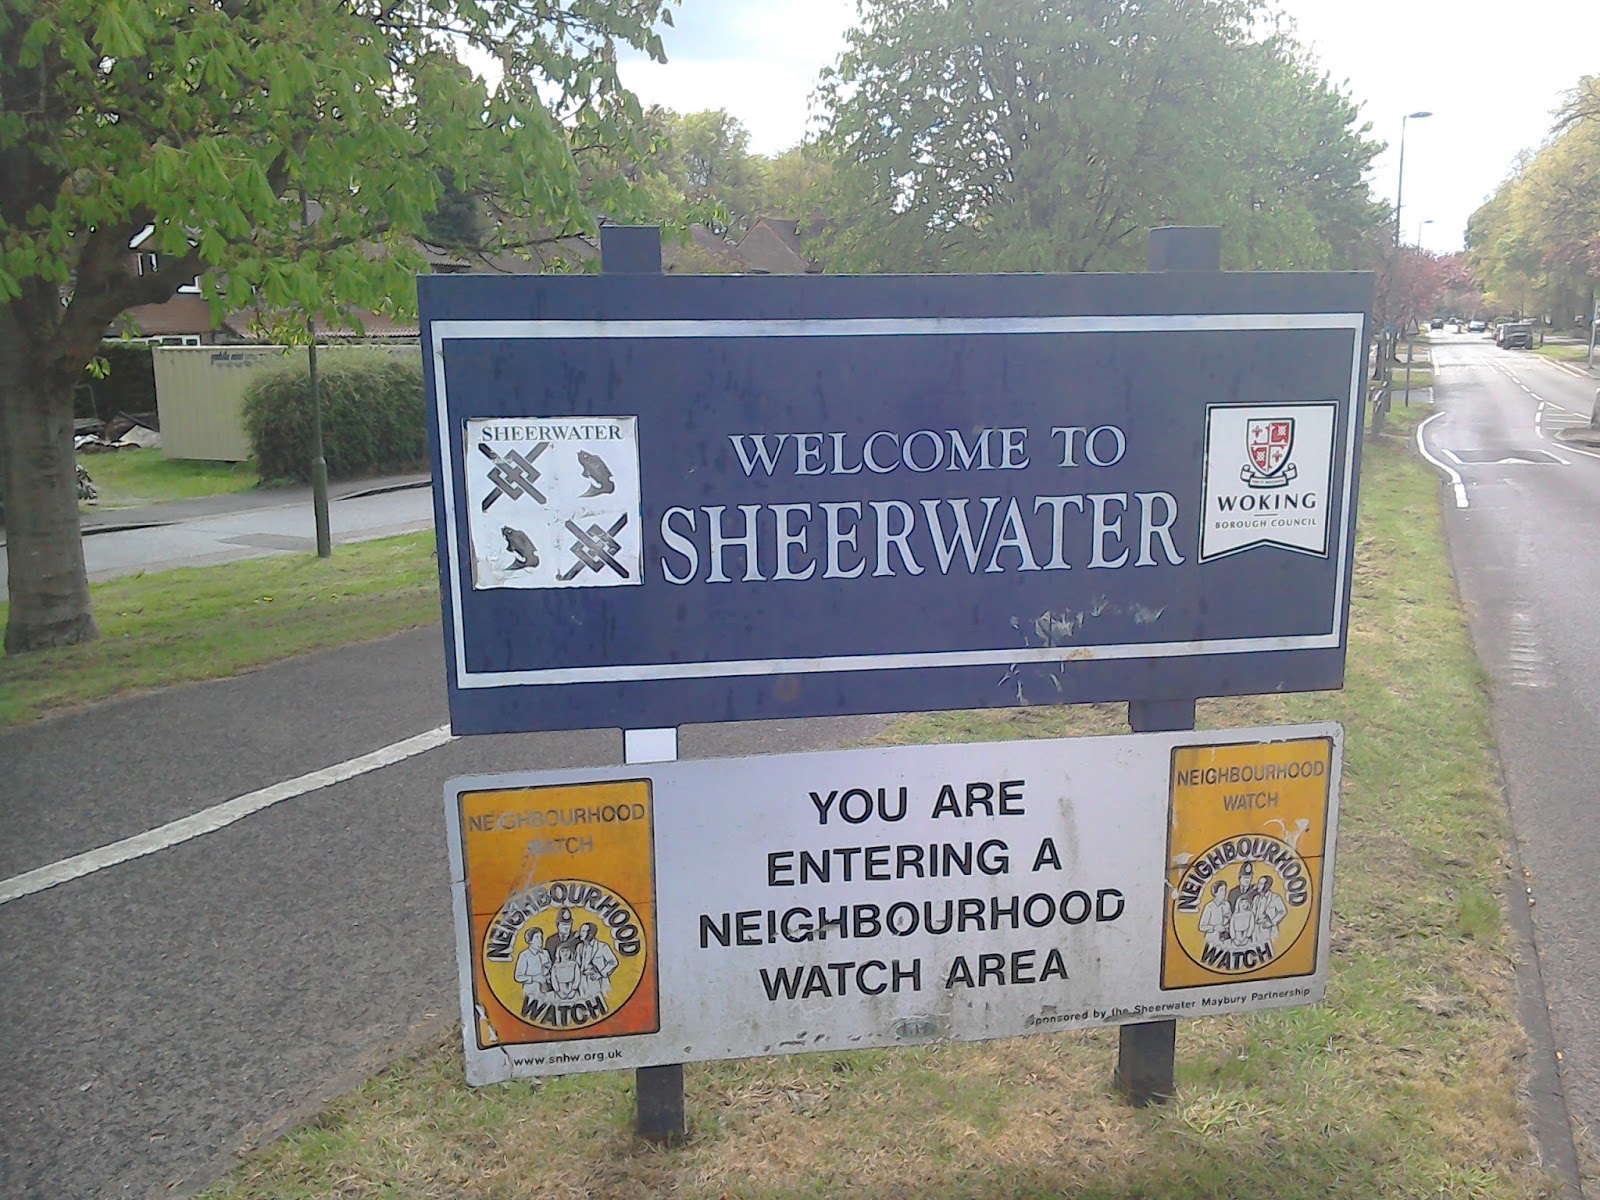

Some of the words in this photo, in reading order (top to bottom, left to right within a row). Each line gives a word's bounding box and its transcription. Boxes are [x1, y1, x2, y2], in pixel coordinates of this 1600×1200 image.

[482, 425, 623, 442] SHEERWATER
[728, 427, 1031, 476] WELCOME
[1051, 424, 1127, 467] TO
[1217, 492, 1316, 511] WOKING
[660, 491, 1185, 585] SHEERWATER
[1215, 519, 1267, 529] BOROUGH
[1271, 518, 1317, 527] COUNCIL
[1177, 760, 1325, 787] NEIGHBOURHOOD
[809, 786, 907, 825] YOU
[932, 780, 1026, 819] ARE
[1223, 792, 1279, 811] WATCH
[469, 803, 645, 832] NEIGHBOURHOOD
[767, 839, 1010, 886] ENTERING
[1032, 837, 1062, 871] A
[1177, 837, 1308, 913] NEIGHBOURHOOD
[699, 888, 1125, 948] NEIGHBOURHOOD
[1201, 942, 1275, 971] WATCH
[760, 958, 921, 1001] WATCH
[945, 948, 1068, 988] AREA
[522, 995, 609, 1026] WATCH
[1093, 1009, 1106, 1019] by
[1134, 1000, 1196, 1014] Sheerwater
[1201, 995, 1247, 1007] Maybury
[1251, 987, 1310, 1001] Partnership
